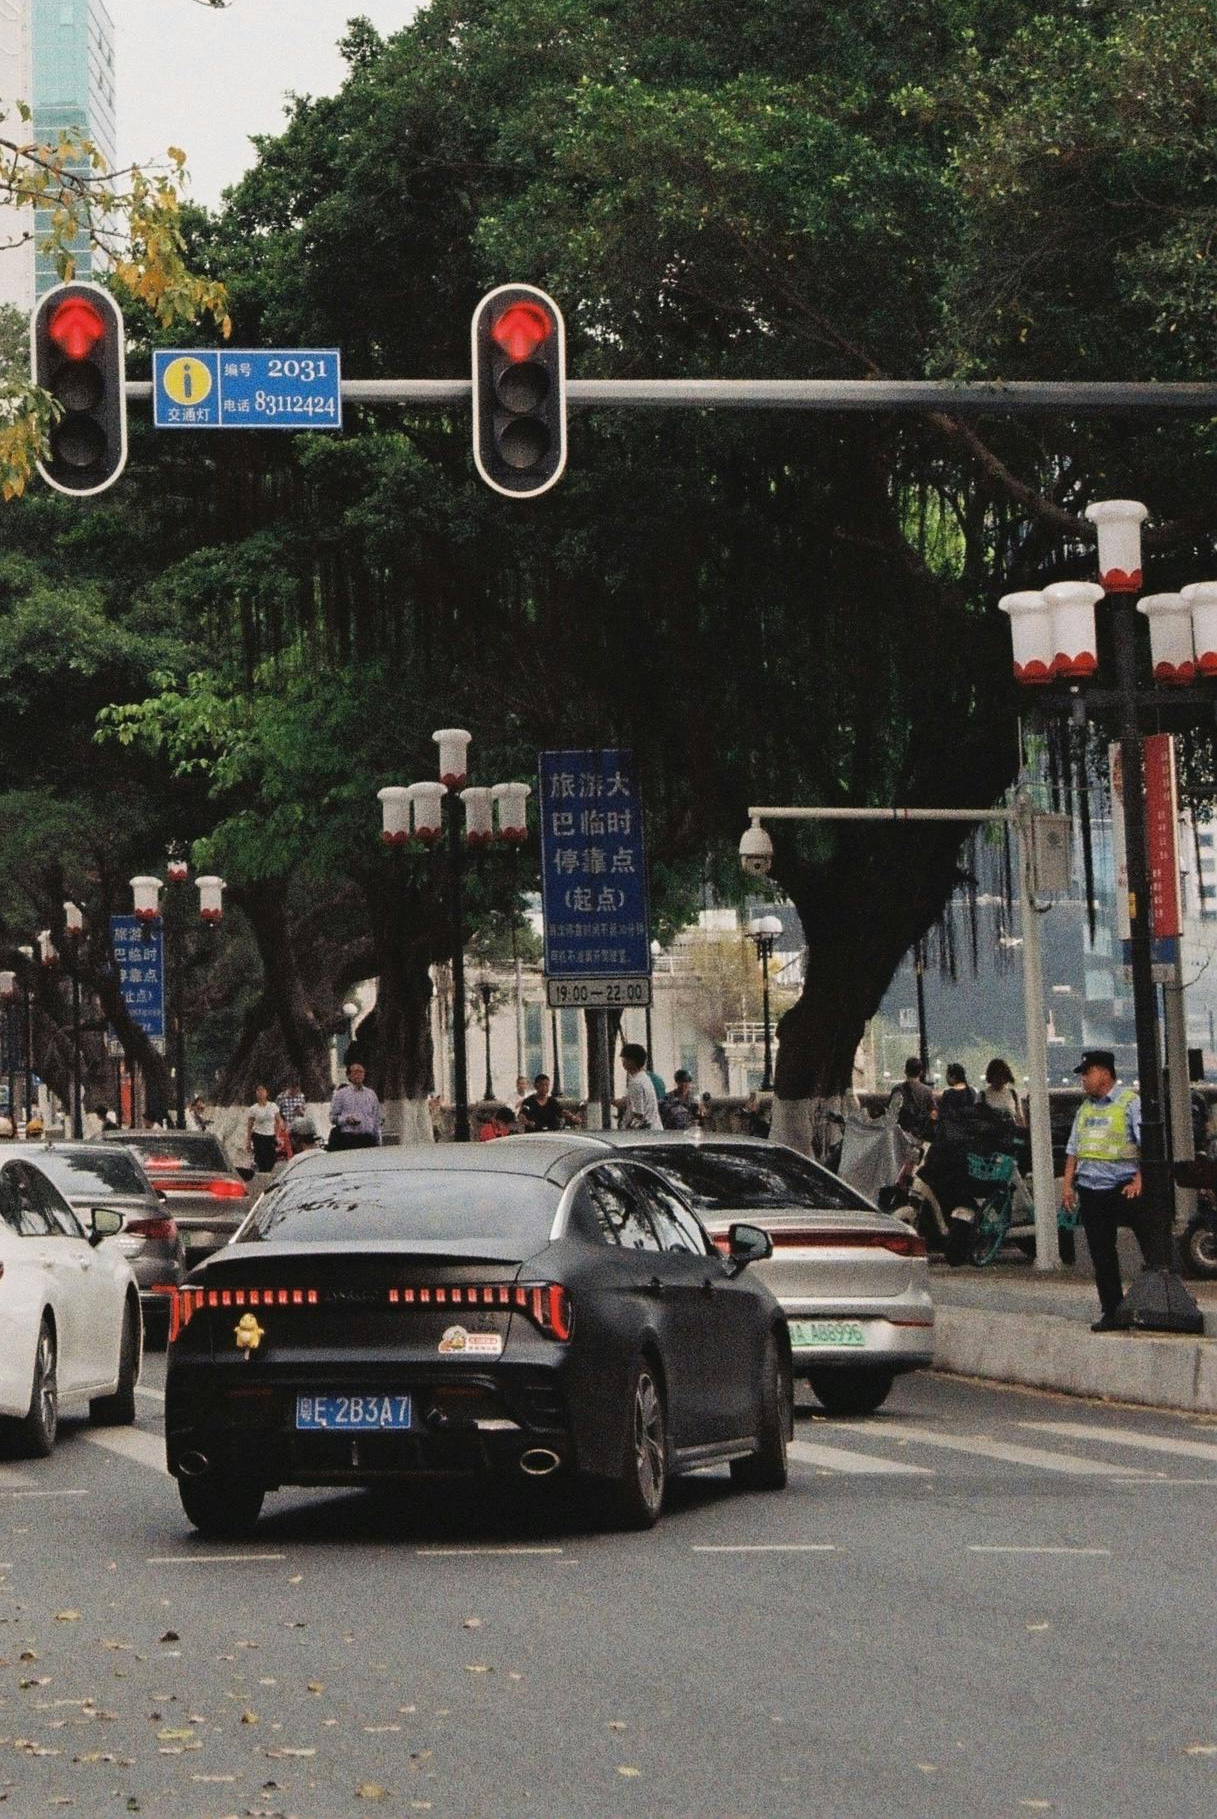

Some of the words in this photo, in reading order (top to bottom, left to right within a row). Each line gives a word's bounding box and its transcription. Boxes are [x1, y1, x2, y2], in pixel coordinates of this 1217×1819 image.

[268, 360, 327, 381] 2031
[167, 407, 210, 422] 交通灯
[224, 398, 250, 413] 电话
[255, 390, 335, 416] 83112424
[550, 771, 631, 798] 旅游大
[552, 809, 632, 837] 巴临时
[553, 848, 635, 875] 停靠点
[114, 926, 157, 942] 旅游
